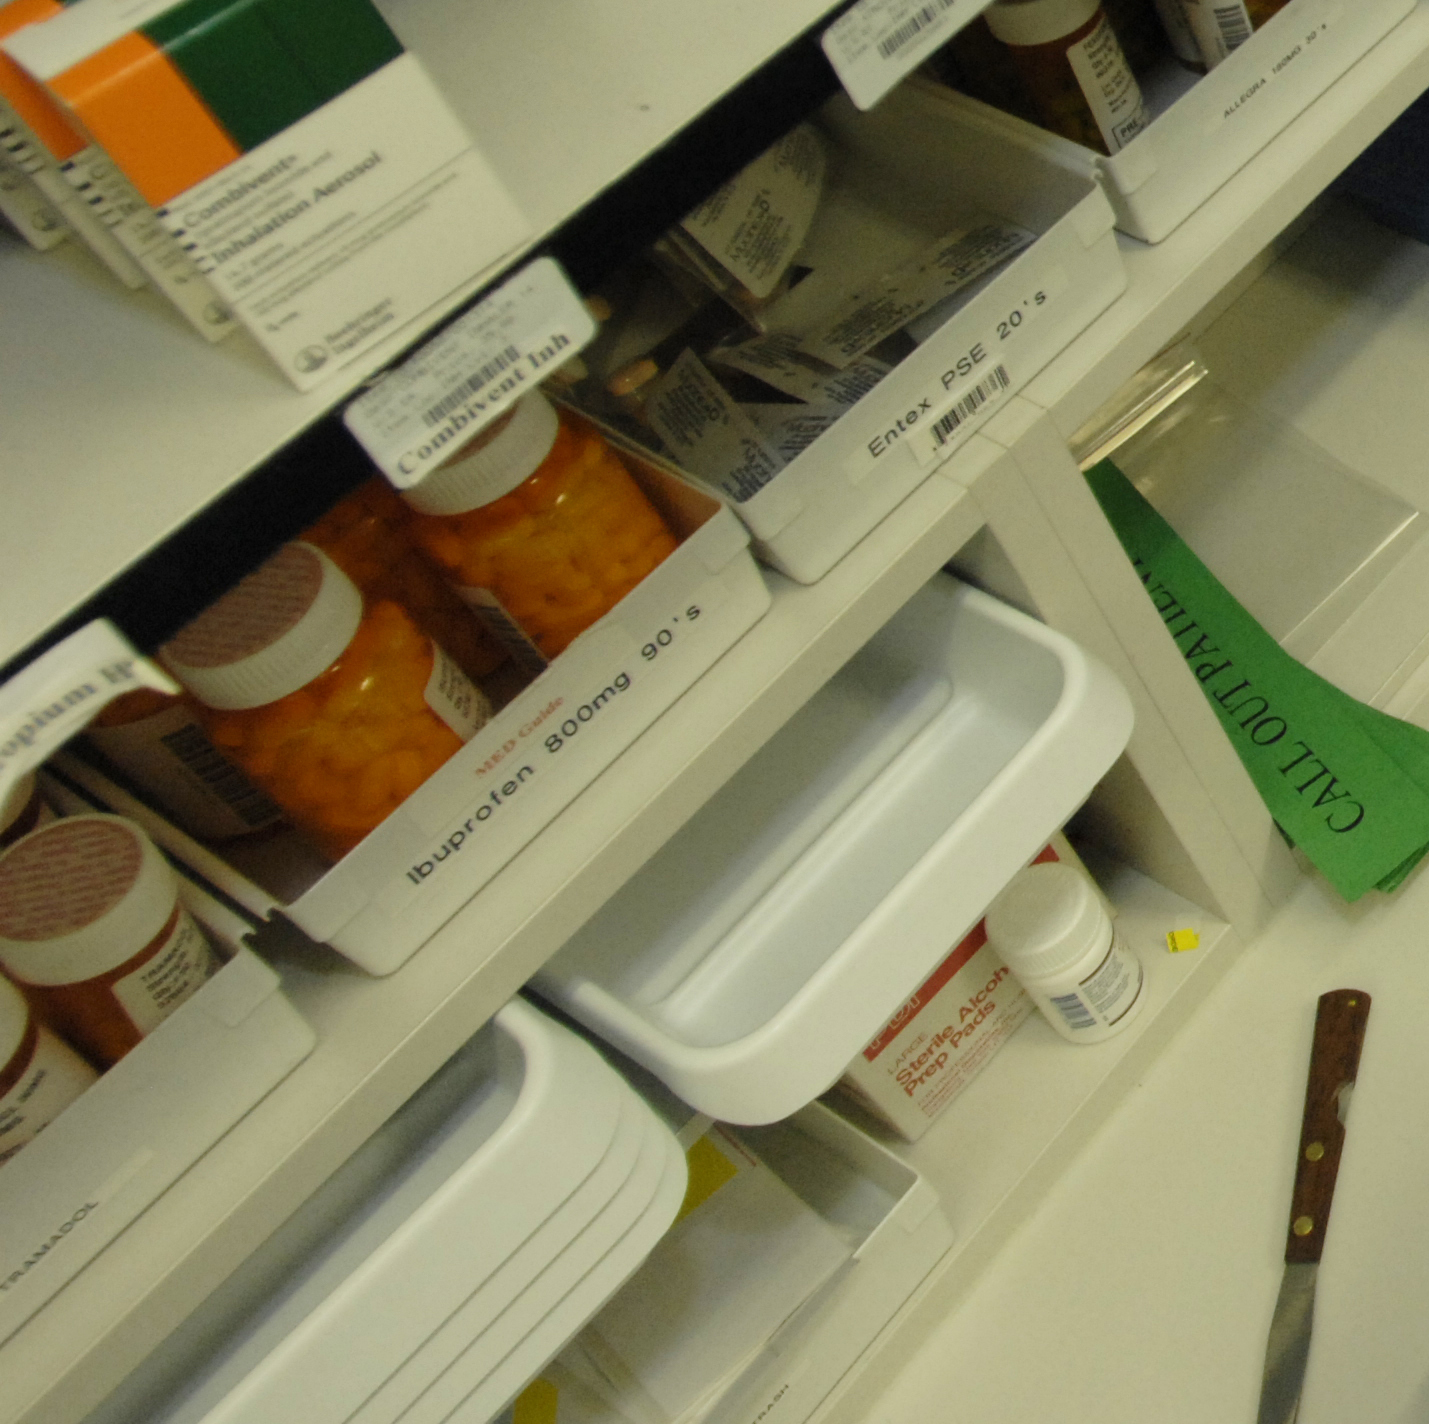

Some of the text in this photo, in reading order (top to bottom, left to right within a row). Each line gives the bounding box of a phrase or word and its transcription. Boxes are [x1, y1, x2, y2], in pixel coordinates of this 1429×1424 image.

[1222, 77, 1268, 120] ALLEGRA
[182, 156, 291, 228] Combivent
[211, 149, 384, 265] Inhalation Aerosol
[395, 363, 527, 478] Combivent
[525, 328, 572, 371] Inh
[865, 287, 1050, 462] Entex PSE 20's
[405, 603, 702, 886] Ibuprofen 800mg 90's
[473, 695, 566, 779] MED Guide
[1211, 678, 1289, 747] OUT
[1277, 740, 1365, 835] CALL
[886, 1031, 929, 1077] LARGE
[895, 1025, 955, 1088] Sterile
[903, 1051, 950, 1098] Prep
[948, 1000, 997, 1049] Pads
